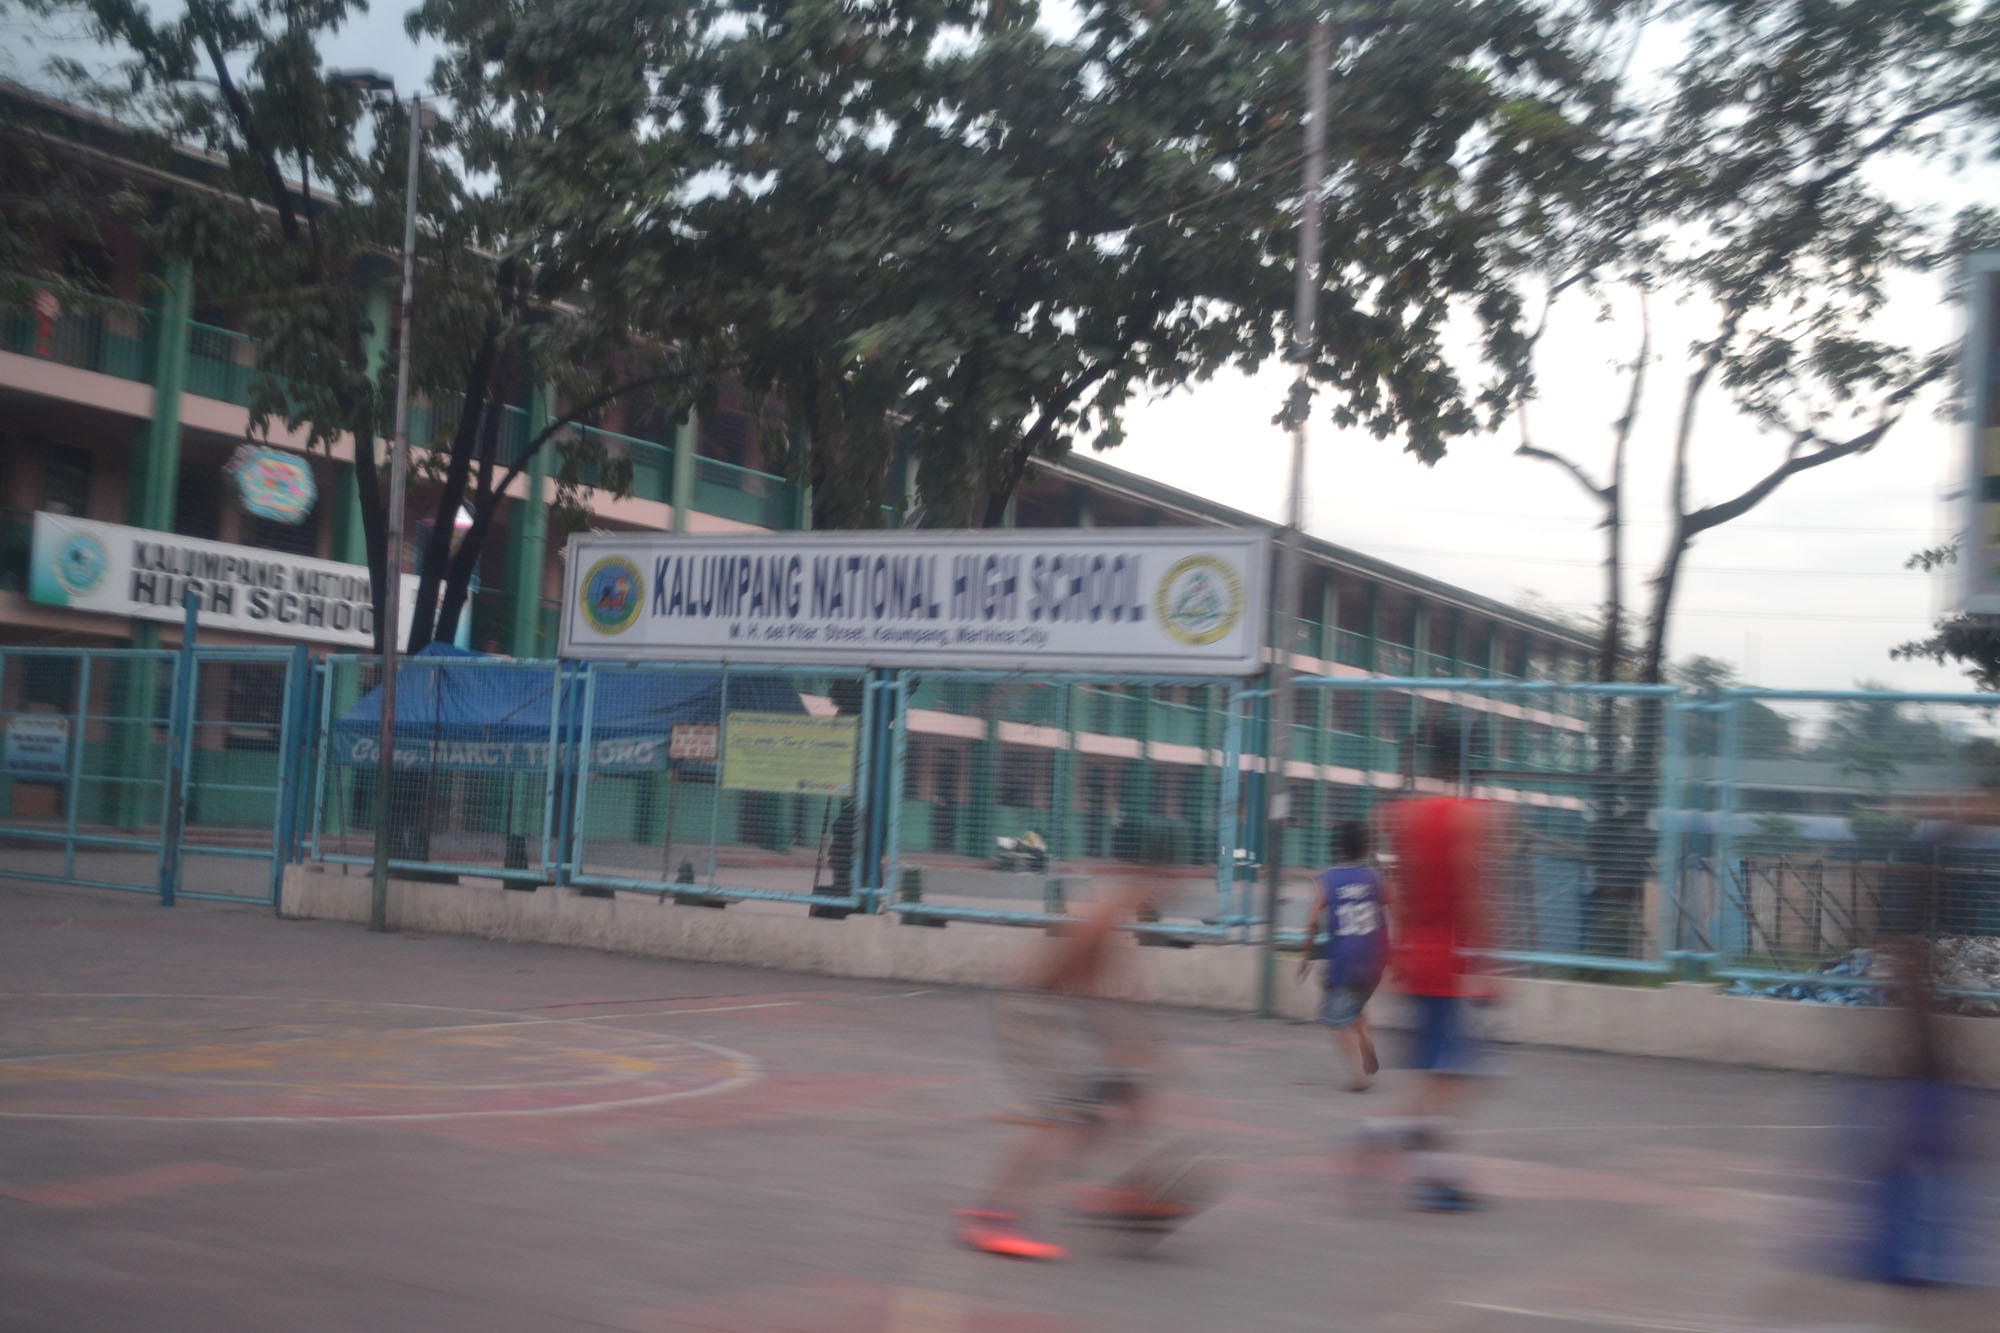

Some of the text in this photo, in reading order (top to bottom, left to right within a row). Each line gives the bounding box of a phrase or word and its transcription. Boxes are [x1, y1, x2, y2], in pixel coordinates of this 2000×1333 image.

[132, 570, 374, 634] HIGH SCHOO
[133, 540, 371, 604] KALUMPANG NATION
[652, 553, 1145, 622] KALUMPANG NATIONAL HIGH SCHOOL
